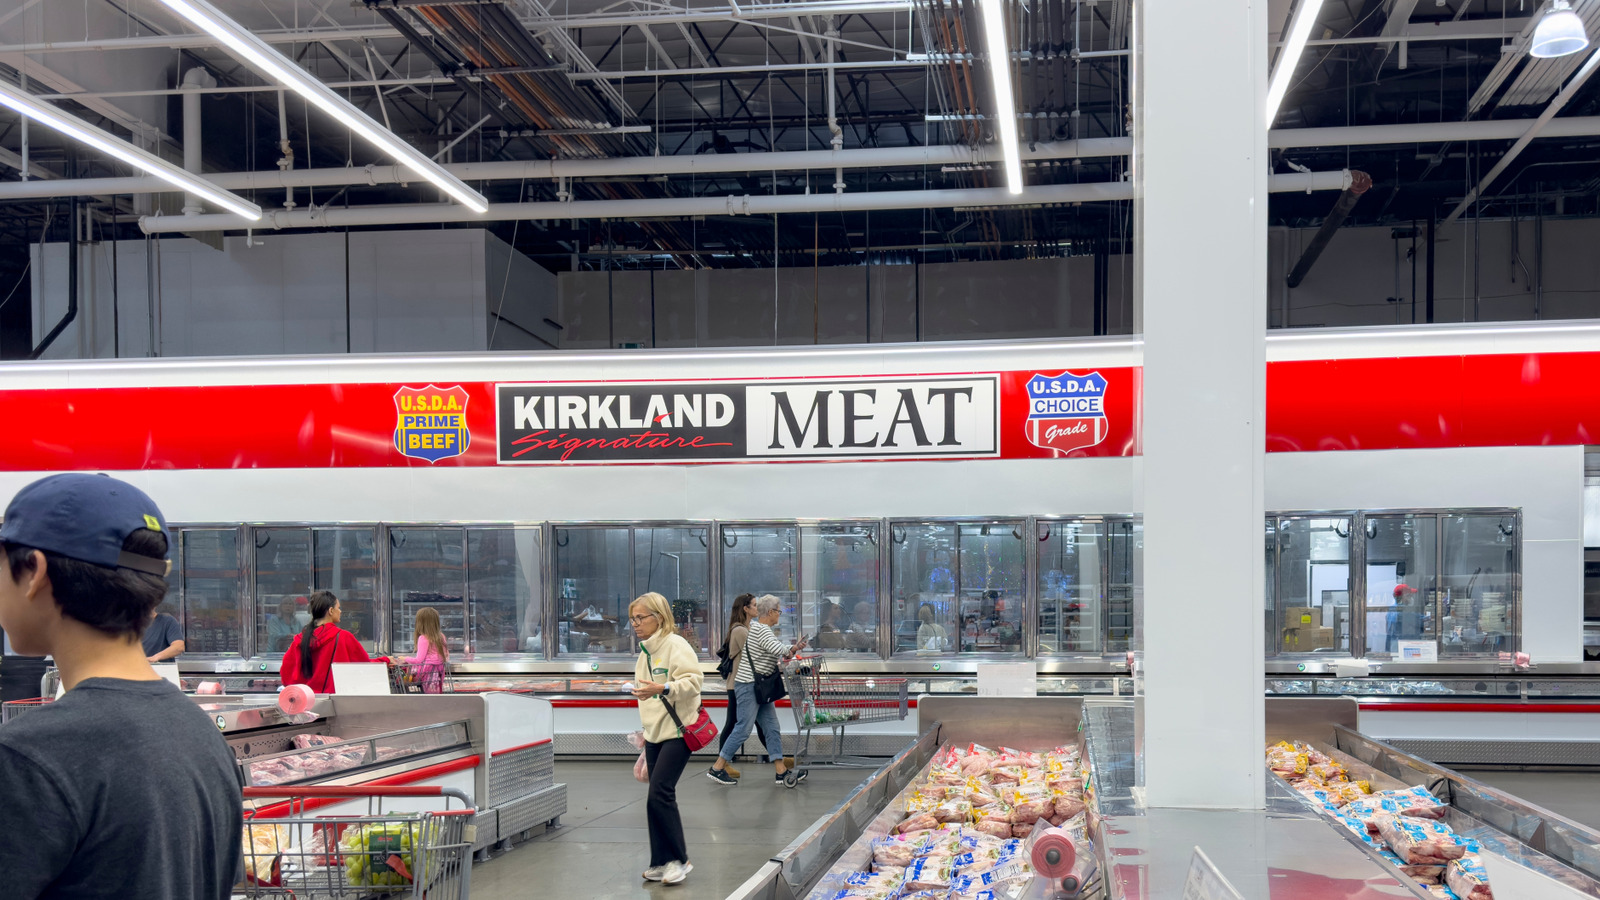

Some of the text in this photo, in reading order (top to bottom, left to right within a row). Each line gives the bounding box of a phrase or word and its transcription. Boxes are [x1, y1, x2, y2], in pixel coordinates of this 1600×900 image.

[1033, 379, 1100, 394] U.S.D.A.
[401, 395, 462, 411] U.S.D.A.
[1034, 398, 1099, 413] CHOICE
[513, 393, 735, 430] KIRKLAND
[767, 386, 973, 450] MEAT
[404, 415, 460, 427] PRIME
[1045, 421, 1088, 444] Grade
[408, 433, 455, 449] BEEF
[511, 429, 733, 462] Signature
